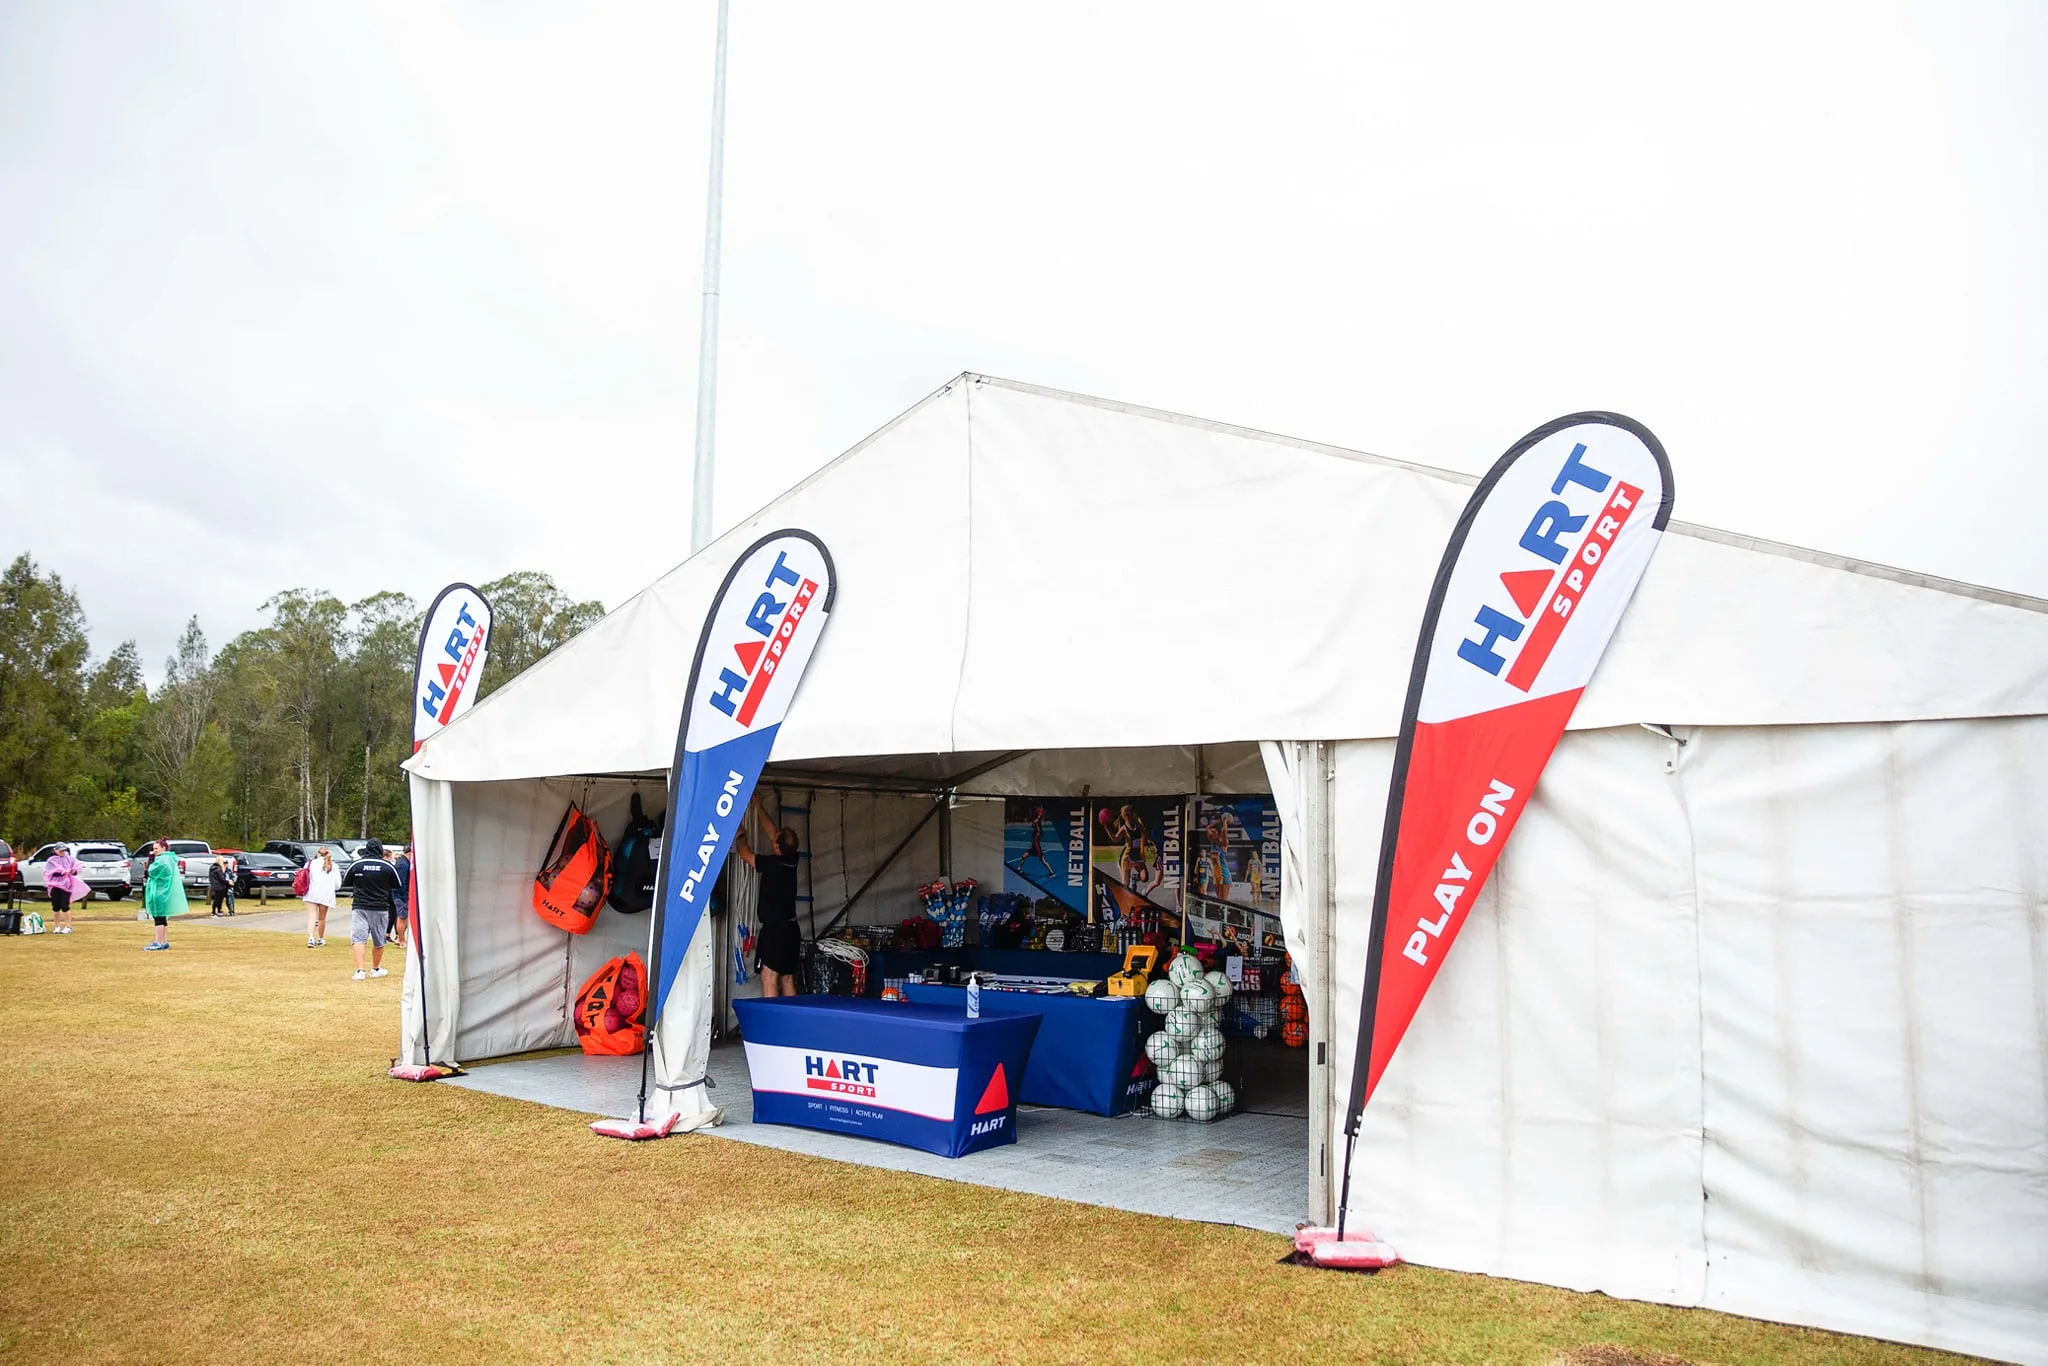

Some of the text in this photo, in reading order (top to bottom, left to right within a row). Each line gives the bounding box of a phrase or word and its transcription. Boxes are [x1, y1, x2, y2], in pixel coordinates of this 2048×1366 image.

[1456, 442, 1612, 677] HART
[1552, 486, 1634, 619] SPORT
[422, 601, 477, 718] HART
[455, 625, 484, 691] SPORT
[709, 550, 801, 717] HART
[763, 582, 814, 676] SPORT
[679, 769, 745, 904] PLAY ON
[1067, 806, 1085, 887] NETBALL
[1162, 804, 1180, 889] NETBALL
[1402, 778, 1517, 966] PLAY ON
[542, 899, 566, 917] HART
[805, 1055, 879, 1084] HART
[808, 1102, 884, 1120] SPORT FITNESS ACTIVE PLAY
[830, 1082, 874, 1096] SPORT
[971, 1116, 1006, 1136] HART
